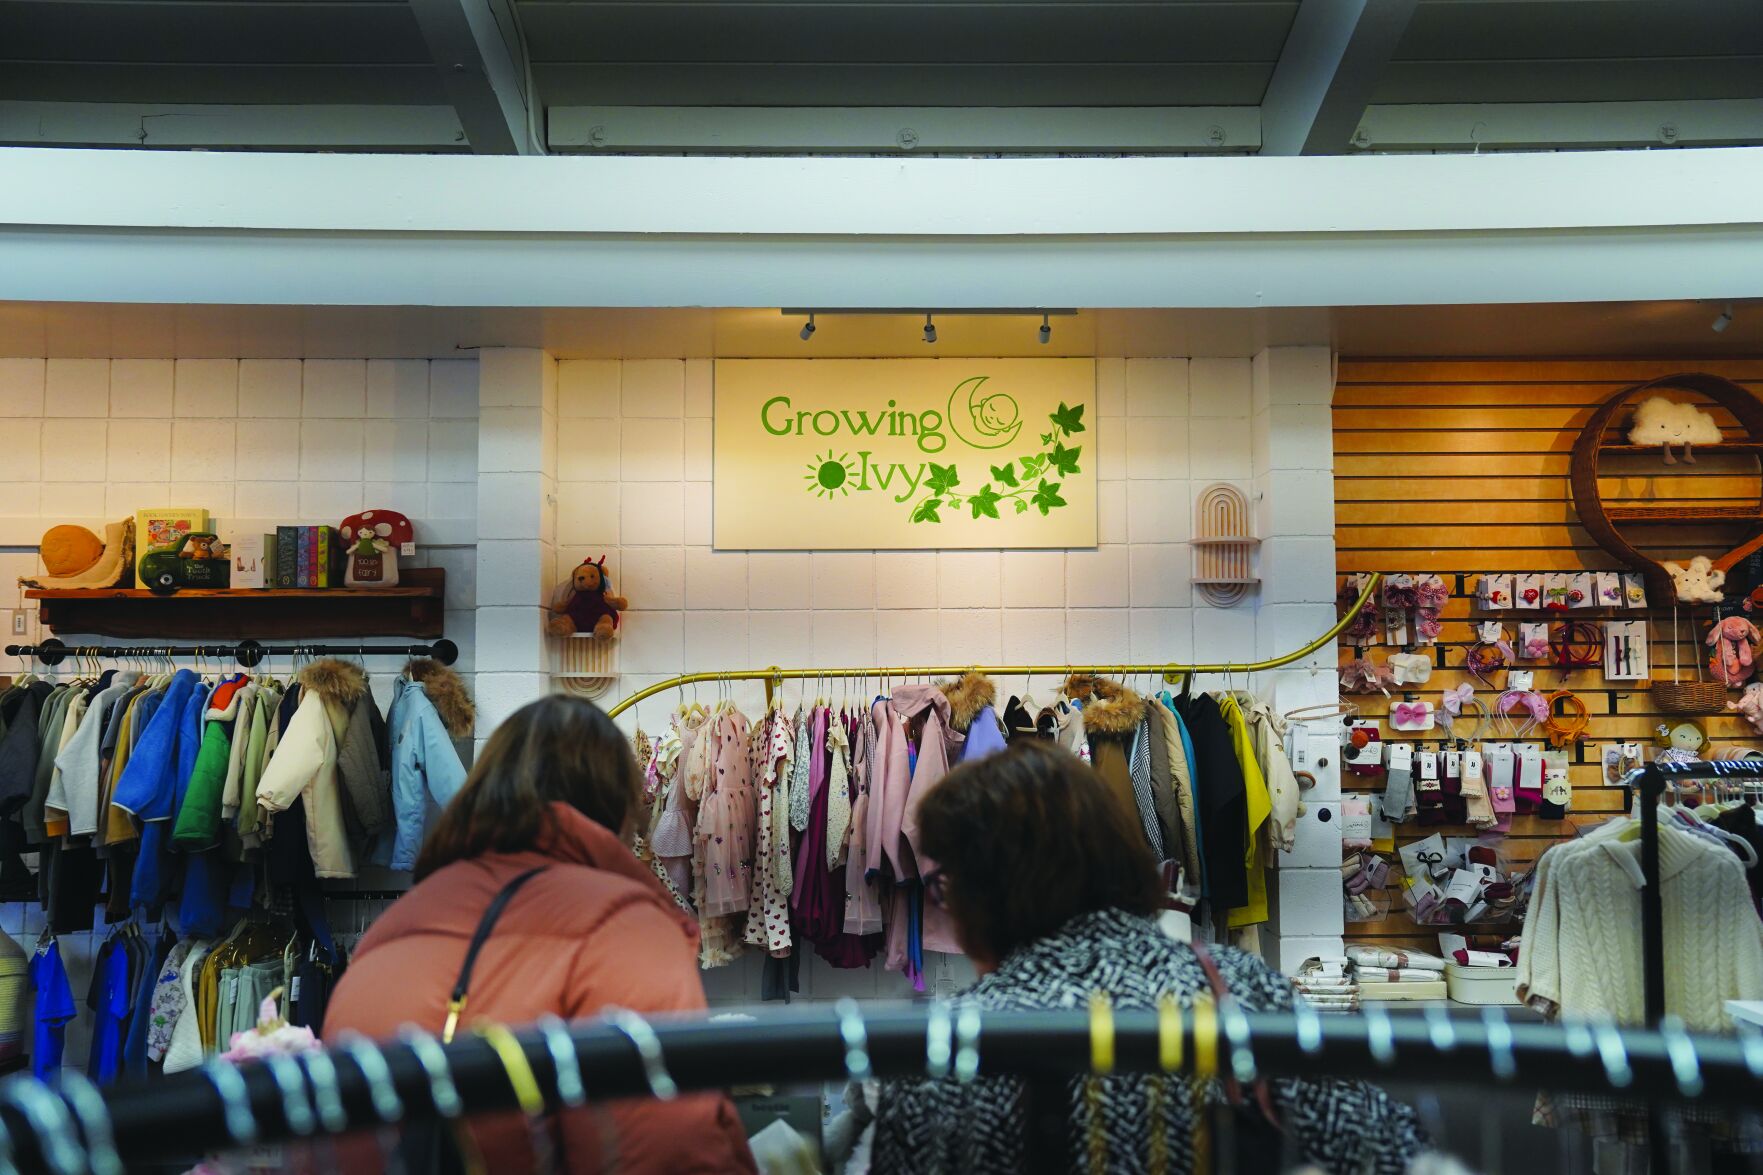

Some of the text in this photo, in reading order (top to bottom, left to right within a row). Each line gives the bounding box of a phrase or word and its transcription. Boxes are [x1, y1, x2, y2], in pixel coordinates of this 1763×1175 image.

[761, 396, 947, 453] Growing
[857, 451, 926, 503] Ivy
[186, 565, 211, 574] Tooth
